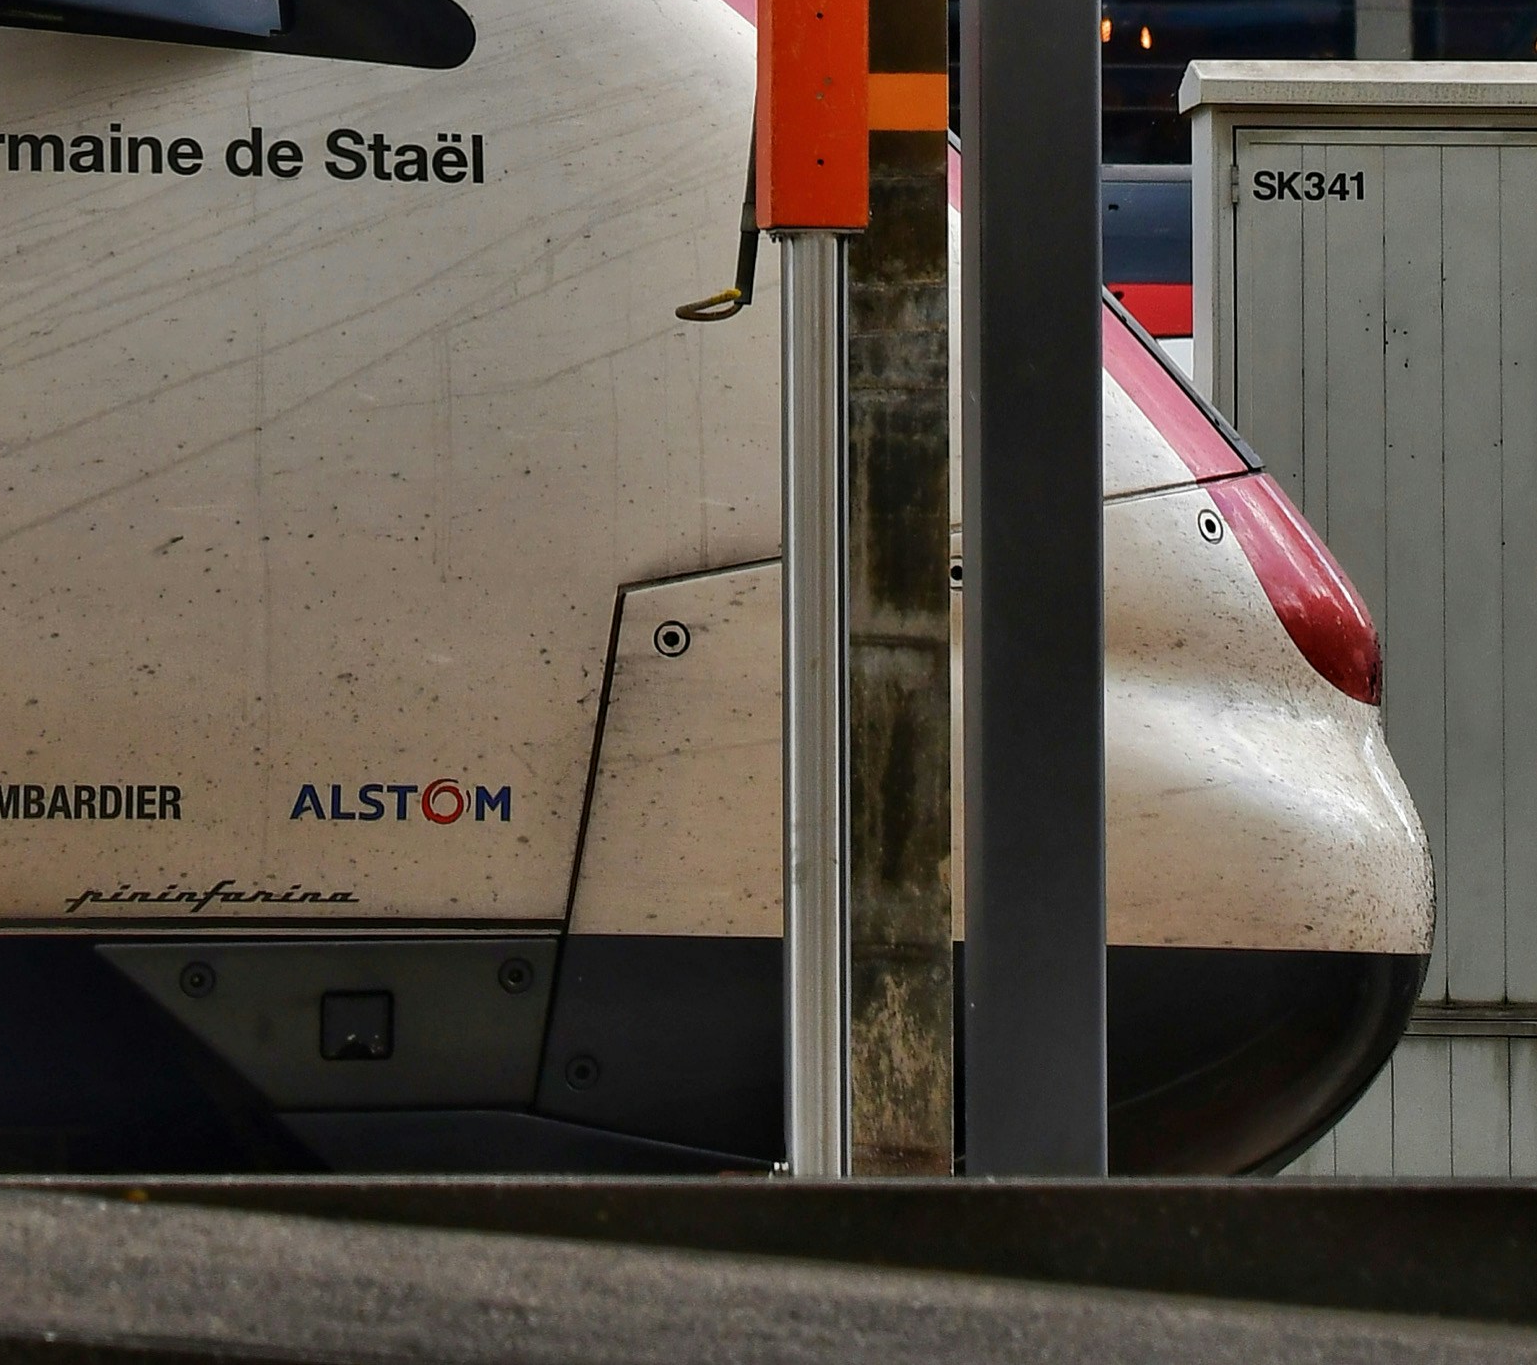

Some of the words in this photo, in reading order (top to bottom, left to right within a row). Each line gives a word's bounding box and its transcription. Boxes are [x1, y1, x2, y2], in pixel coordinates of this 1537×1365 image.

[225, 126, 304, 179] de
[324, 128, 484, 184] Staël
[1252, 170, 1364, 201] SK341
[289, 778, 512, 825] ALSTOM
[64, 879, 360, 913] pininfarina
